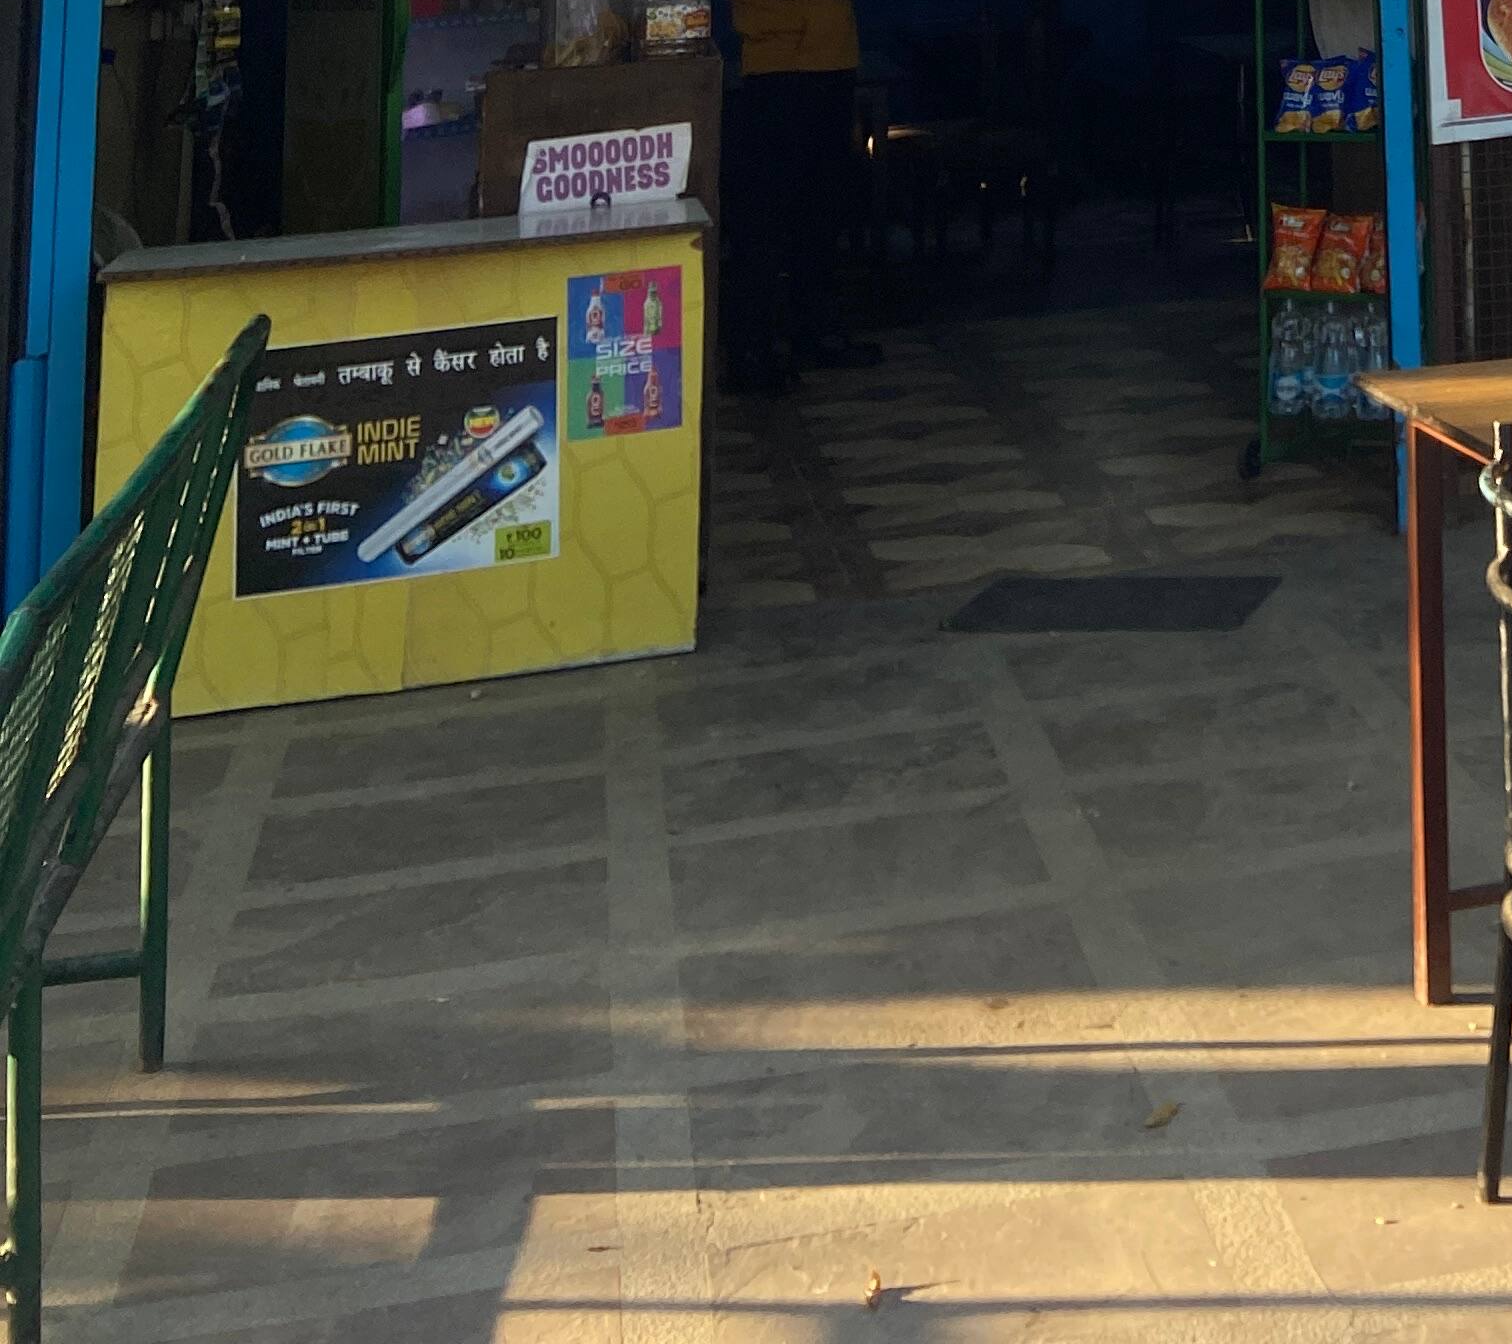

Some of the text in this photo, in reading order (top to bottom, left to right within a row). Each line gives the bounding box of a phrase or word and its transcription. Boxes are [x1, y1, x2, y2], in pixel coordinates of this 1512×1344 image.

[536, 161, 671, 202] GOODNESS
[338, 360, 394, 385] तम्बाकू
[406, 351, 421, 377] से
[433, 347, 478, 373] कैंसर
[488, 341, 526, 367] होता
[536, 336, 550, 362] है
[596, 337, 653, 360] SIZE
[596, 359, 653, 378] PRICE
[357, 415, 422, 443] INDIE
[249, 439, 347, 464] GOLD FLAKE
[357, 438, 420, 465] MINT
